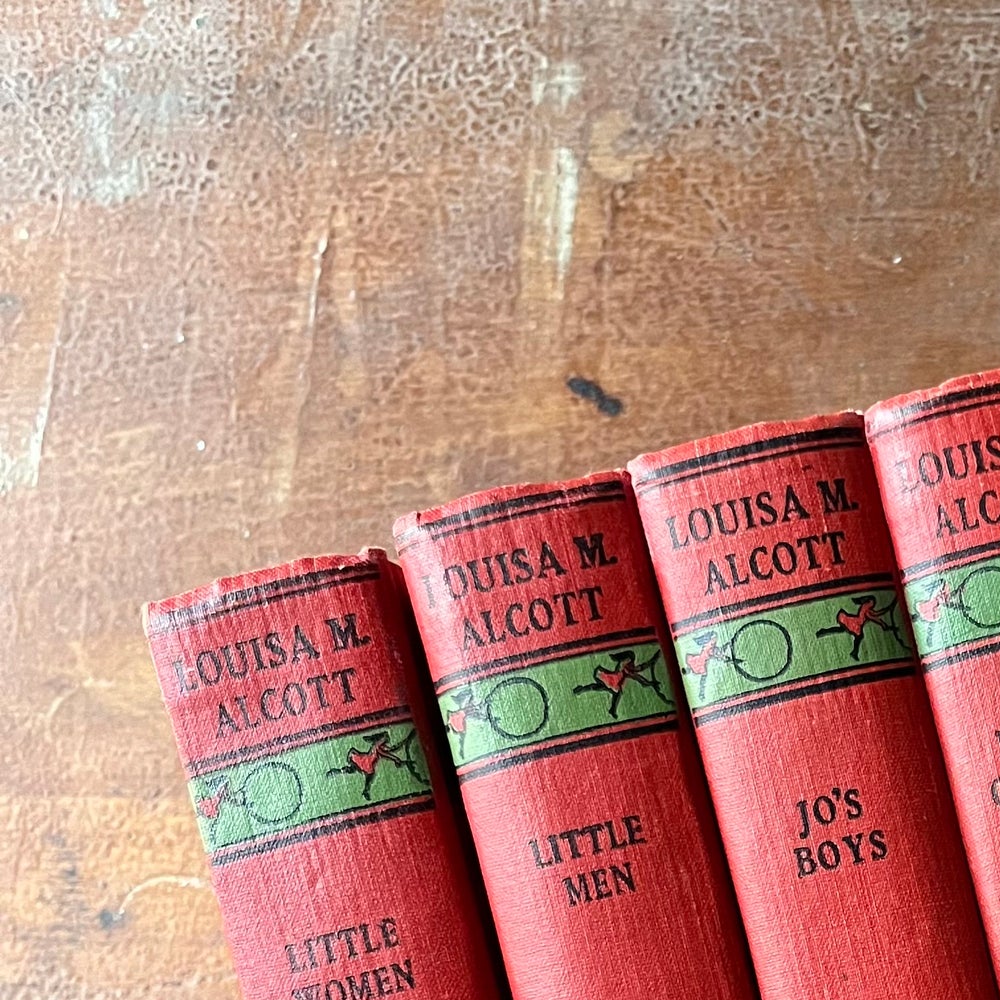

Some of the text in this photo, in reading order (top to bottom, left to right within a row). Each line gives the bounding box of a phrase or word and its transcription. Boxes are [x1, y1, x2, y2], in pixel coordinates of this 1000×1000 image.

[665, 478, 859, 551] LOUISA M.
[573, 532, 618, 570] M.
[705, 531, 846, 596] ALCOTT
[462, 586, 604, 651] ALCOTT
[172, 613, 372, 693] LOUISA M.
[215, 668, 359, 740] ALCOTT
[797, 787, 863, 839] JO'S
[528, 815, 648, 869] LITTLE
[794, 830, 888, 878] BOYS
[562, 862, 636, 907] MEN
[284, 917, 402, 974] LITTLE
